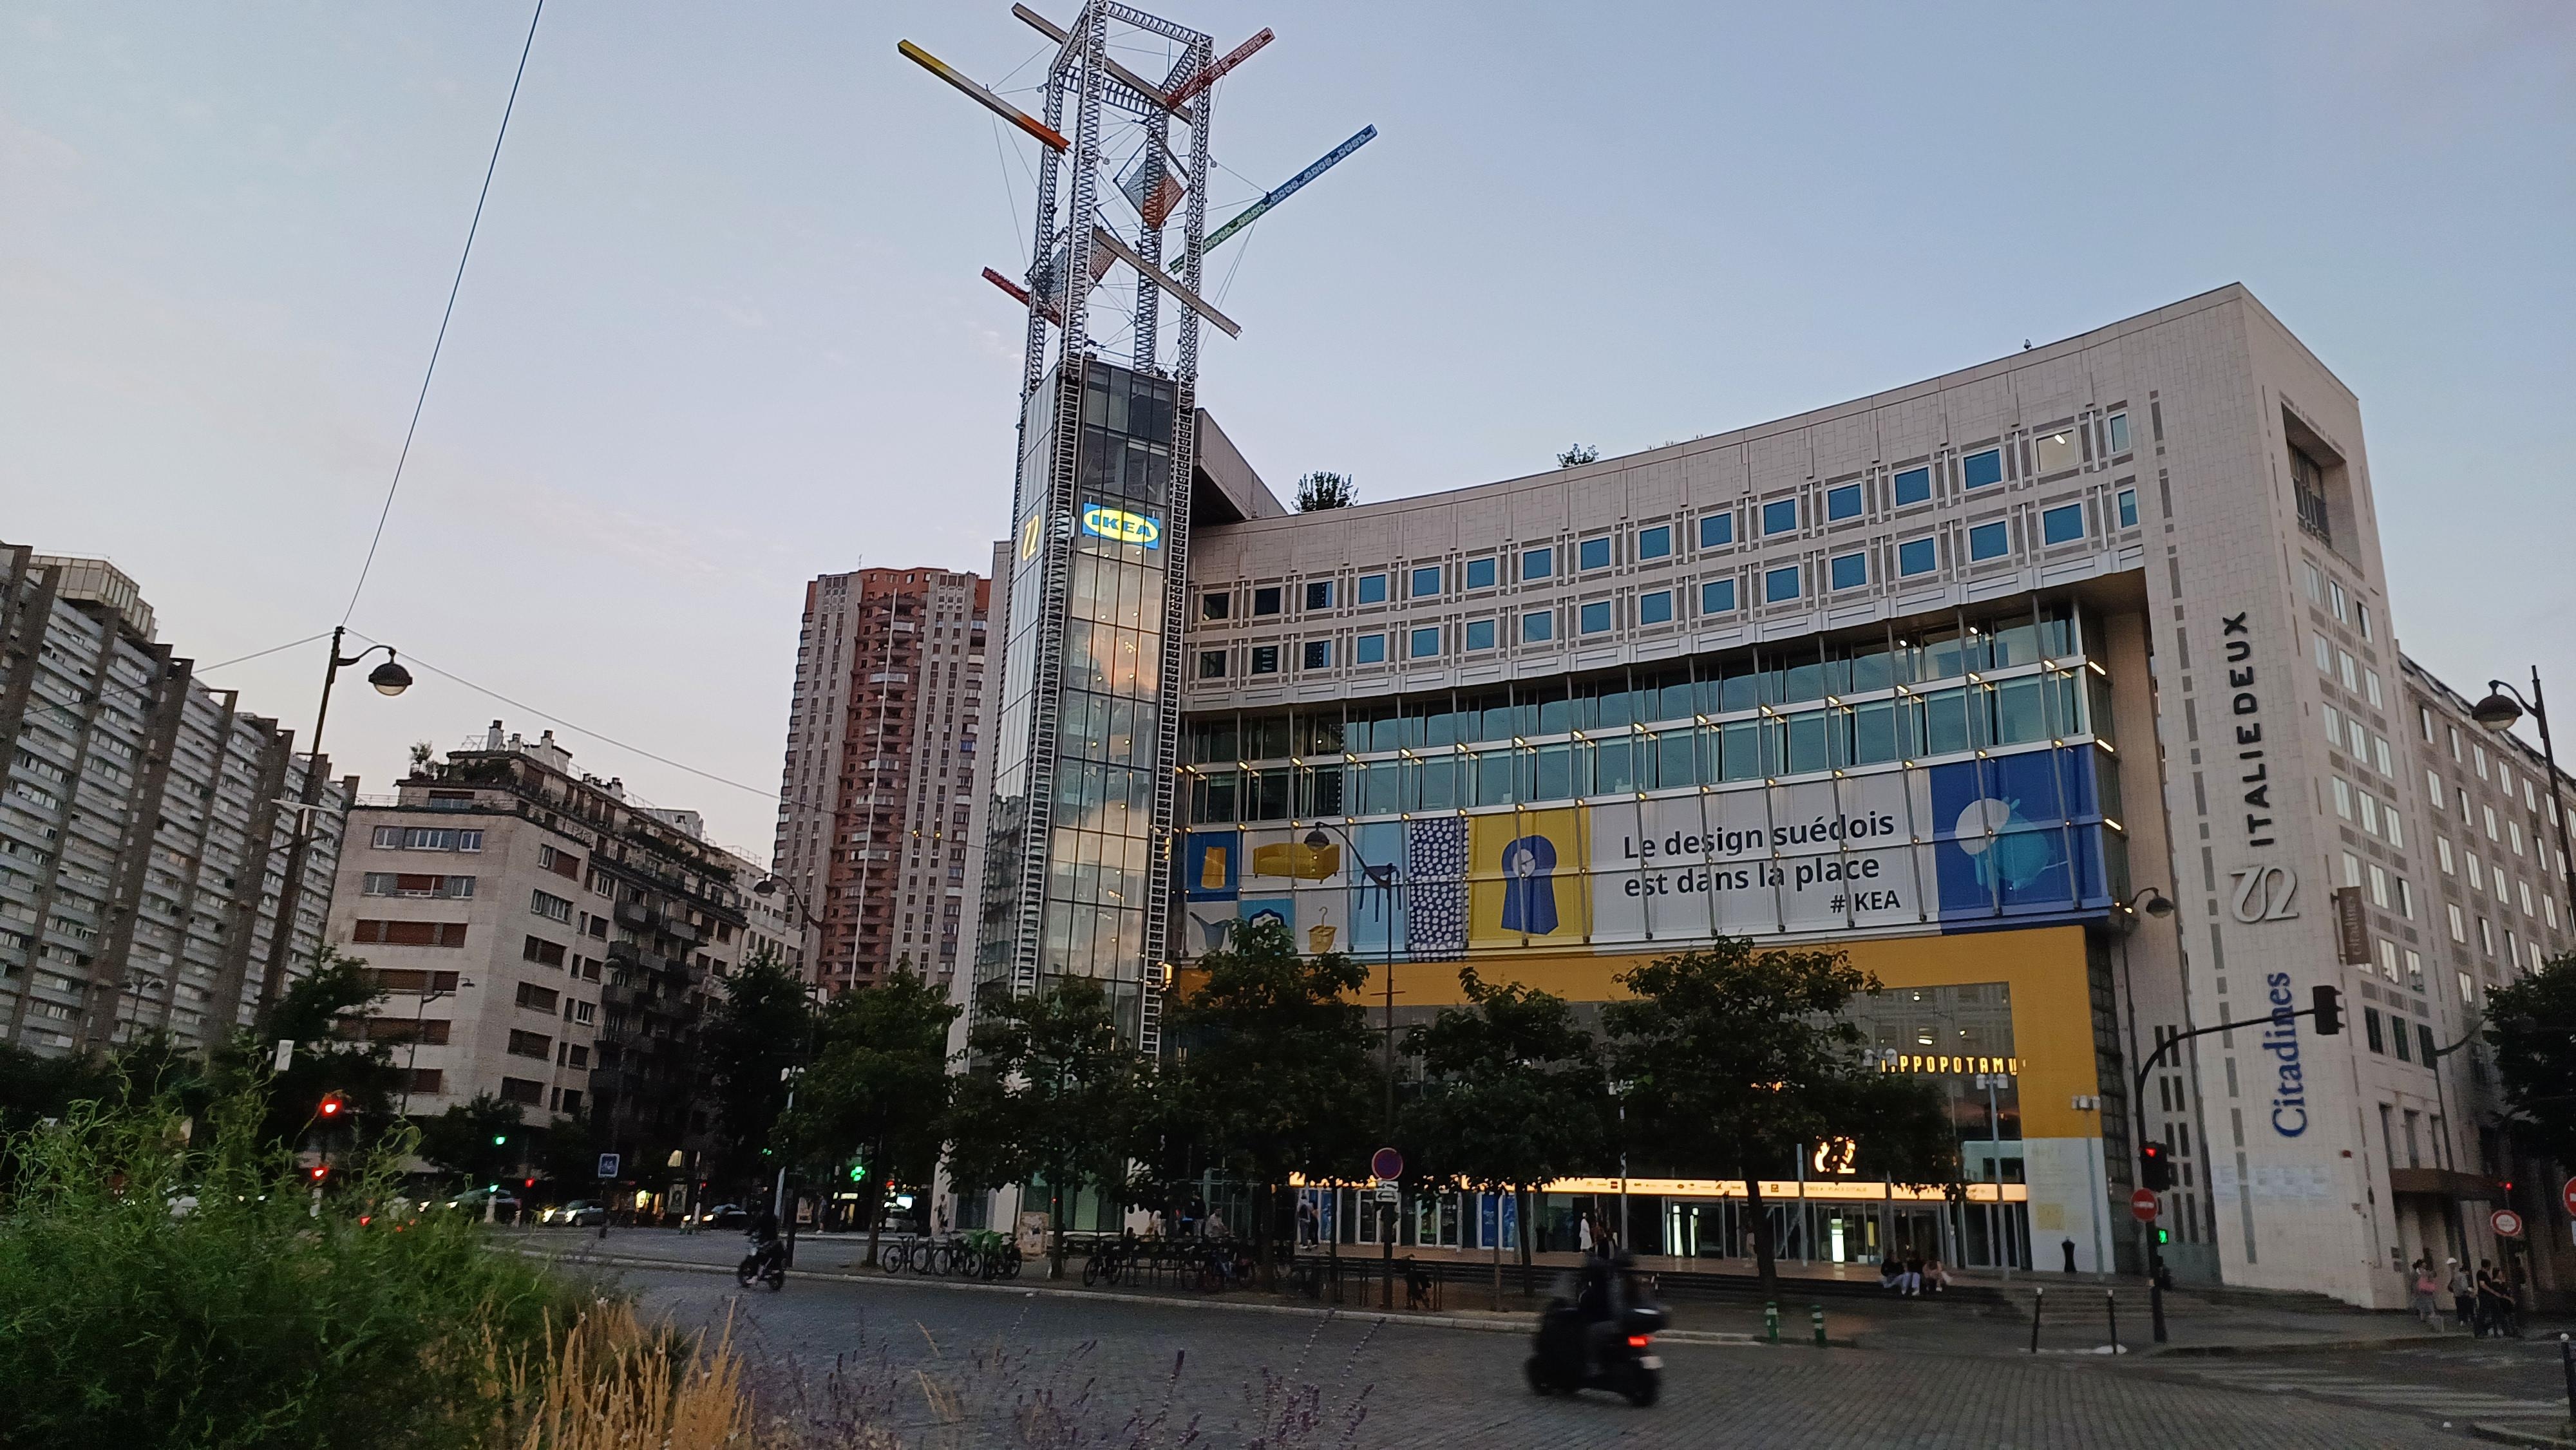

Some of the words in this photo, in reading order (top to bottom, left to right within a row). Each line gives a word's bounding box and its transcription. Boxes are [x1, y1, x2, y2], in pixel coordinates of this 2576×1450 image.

[1091, 514, 1152, 538] IKEA
[1624, 836, 1656, 860] Le
[1665, 826, 1763, 856] design
[1773, 811, 1895, 846] suédois
[1624, 872, 1669, 897] est
[1676, 867, 1750, 893] dans
[1759, 862, 1785, 888] la
[1795, 857, 1880, 892] place
[1880, 1055, 2027, 1077] PPOPOTAMU
[2262, 972, 2307, 1138] Citadines
